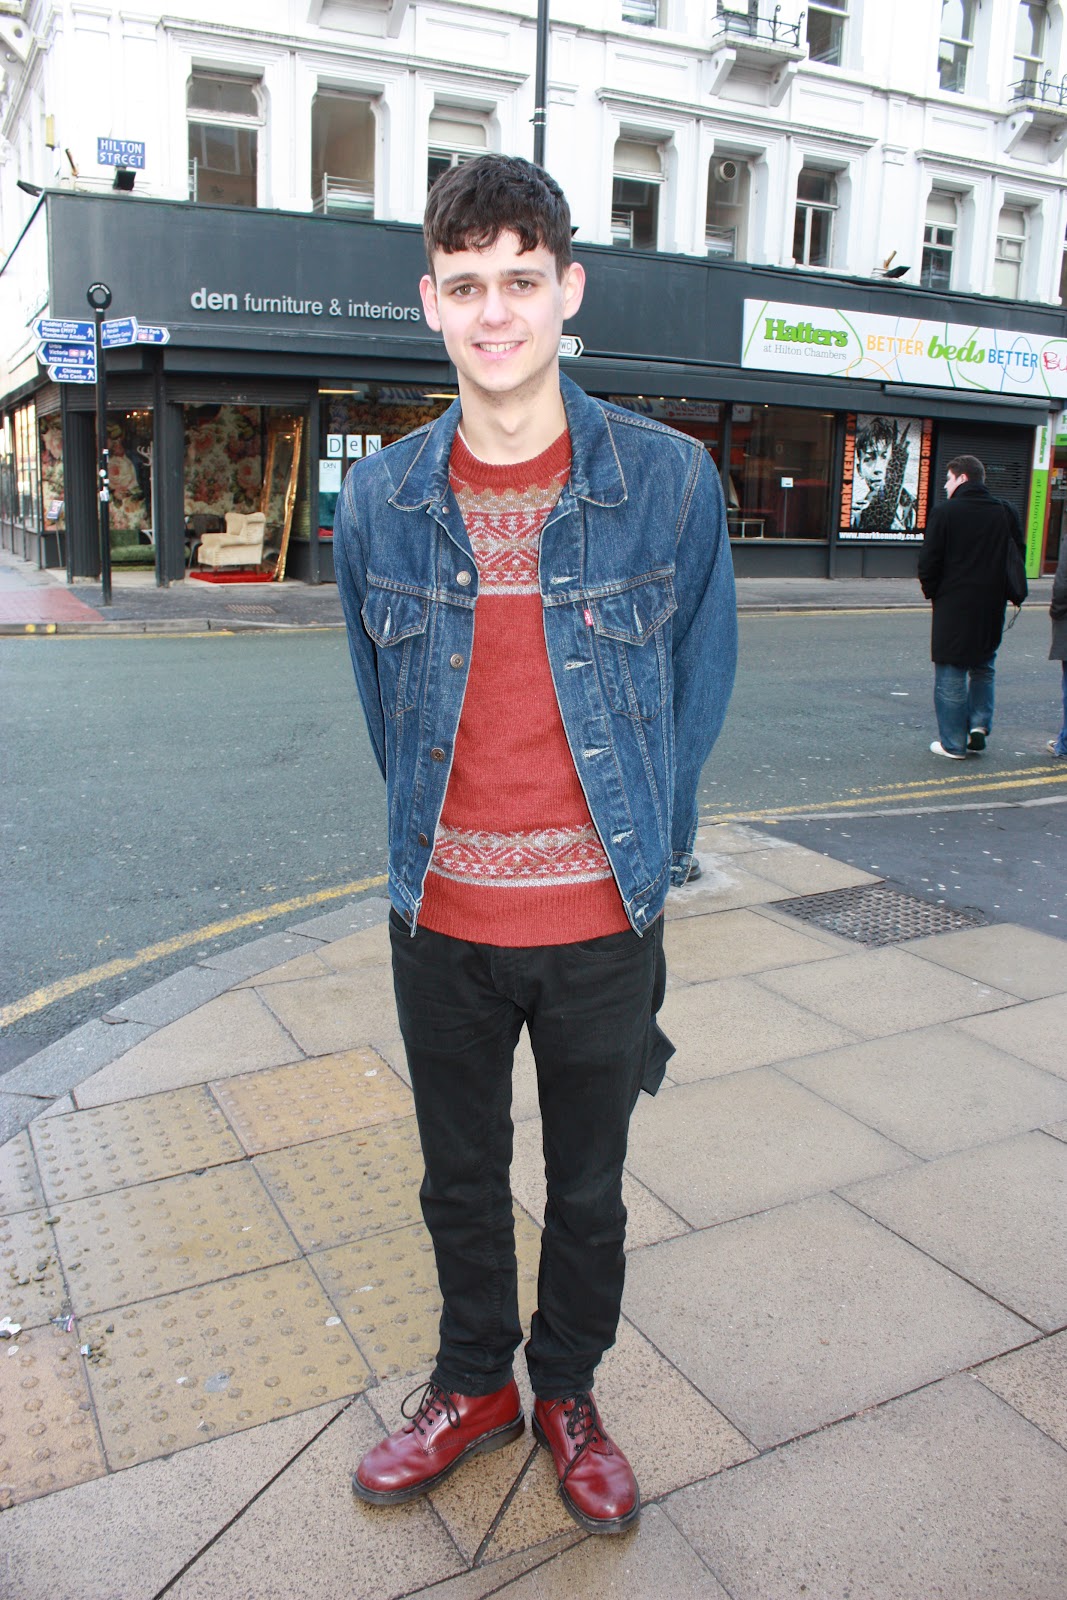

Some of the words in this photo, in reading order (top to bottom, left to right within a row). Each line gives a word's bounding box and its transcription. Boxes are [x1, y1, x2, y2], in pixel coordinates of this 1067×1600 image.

[100, 139, 142, 154] HILTON
[99, 152, 143, 166] STREET
[190, 288, 238, 310] den
[244, 293, 323, 316] furniture
[329, 298, 342, 316] &
[348, 299, 421, 321] interiors
[561, 341, 571, 350] WC
[763, 318, 849, 347] Hatters
[866, 335, 924, 356] BETTER
[927, 335, 986, 364] beds
[988, 349, 1039, 368] BETTER
[763, 345, 772, 353] at
[774, 344, 802, 356] Hilton
[804, 347, 847, 360] Chambers
[917, 458, 931, 529] COMMISSIONS
[840, 483, 853, 528] MARK
[839, 531, 925, 541] www.markkennedy.co.uk
